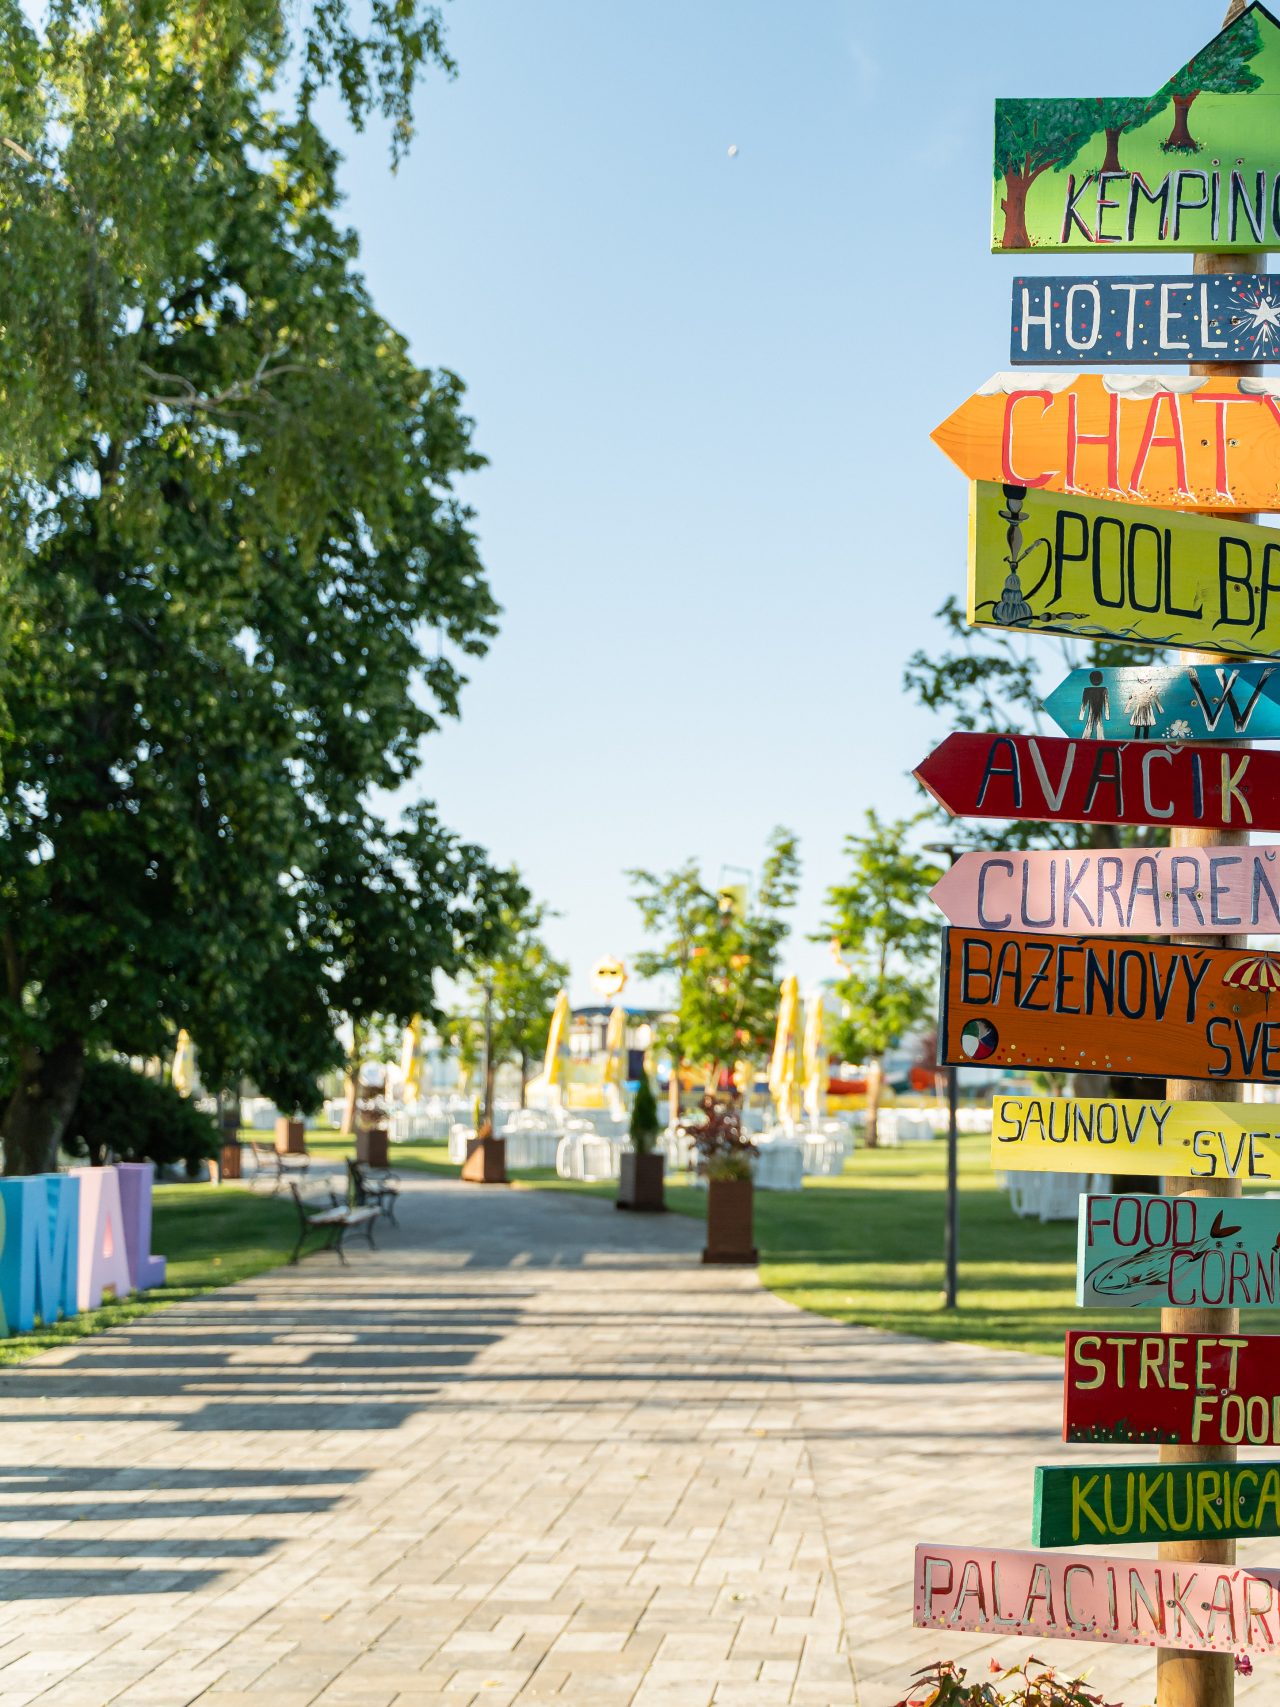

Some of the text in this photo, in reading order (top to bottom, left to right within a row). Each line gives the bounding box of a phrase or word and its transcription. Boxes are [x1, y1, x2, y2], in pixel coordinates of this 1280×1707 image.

[1021, 283, 1228, 351] HOTEL
[1045, 510, 1204, 618] POOL
[976, 737, 1253, 824] AVÁČIK
[960, 937, 1213, 1024] BAZÉNOVÝ
[998, 1100, 1174, 1147] SAUNOVÝ
[0, 1162, 167, 1337] MAL
[1086, 1195, 1197, 1248] FOOD
[1073, 1336, 1249, 1391] STREET
